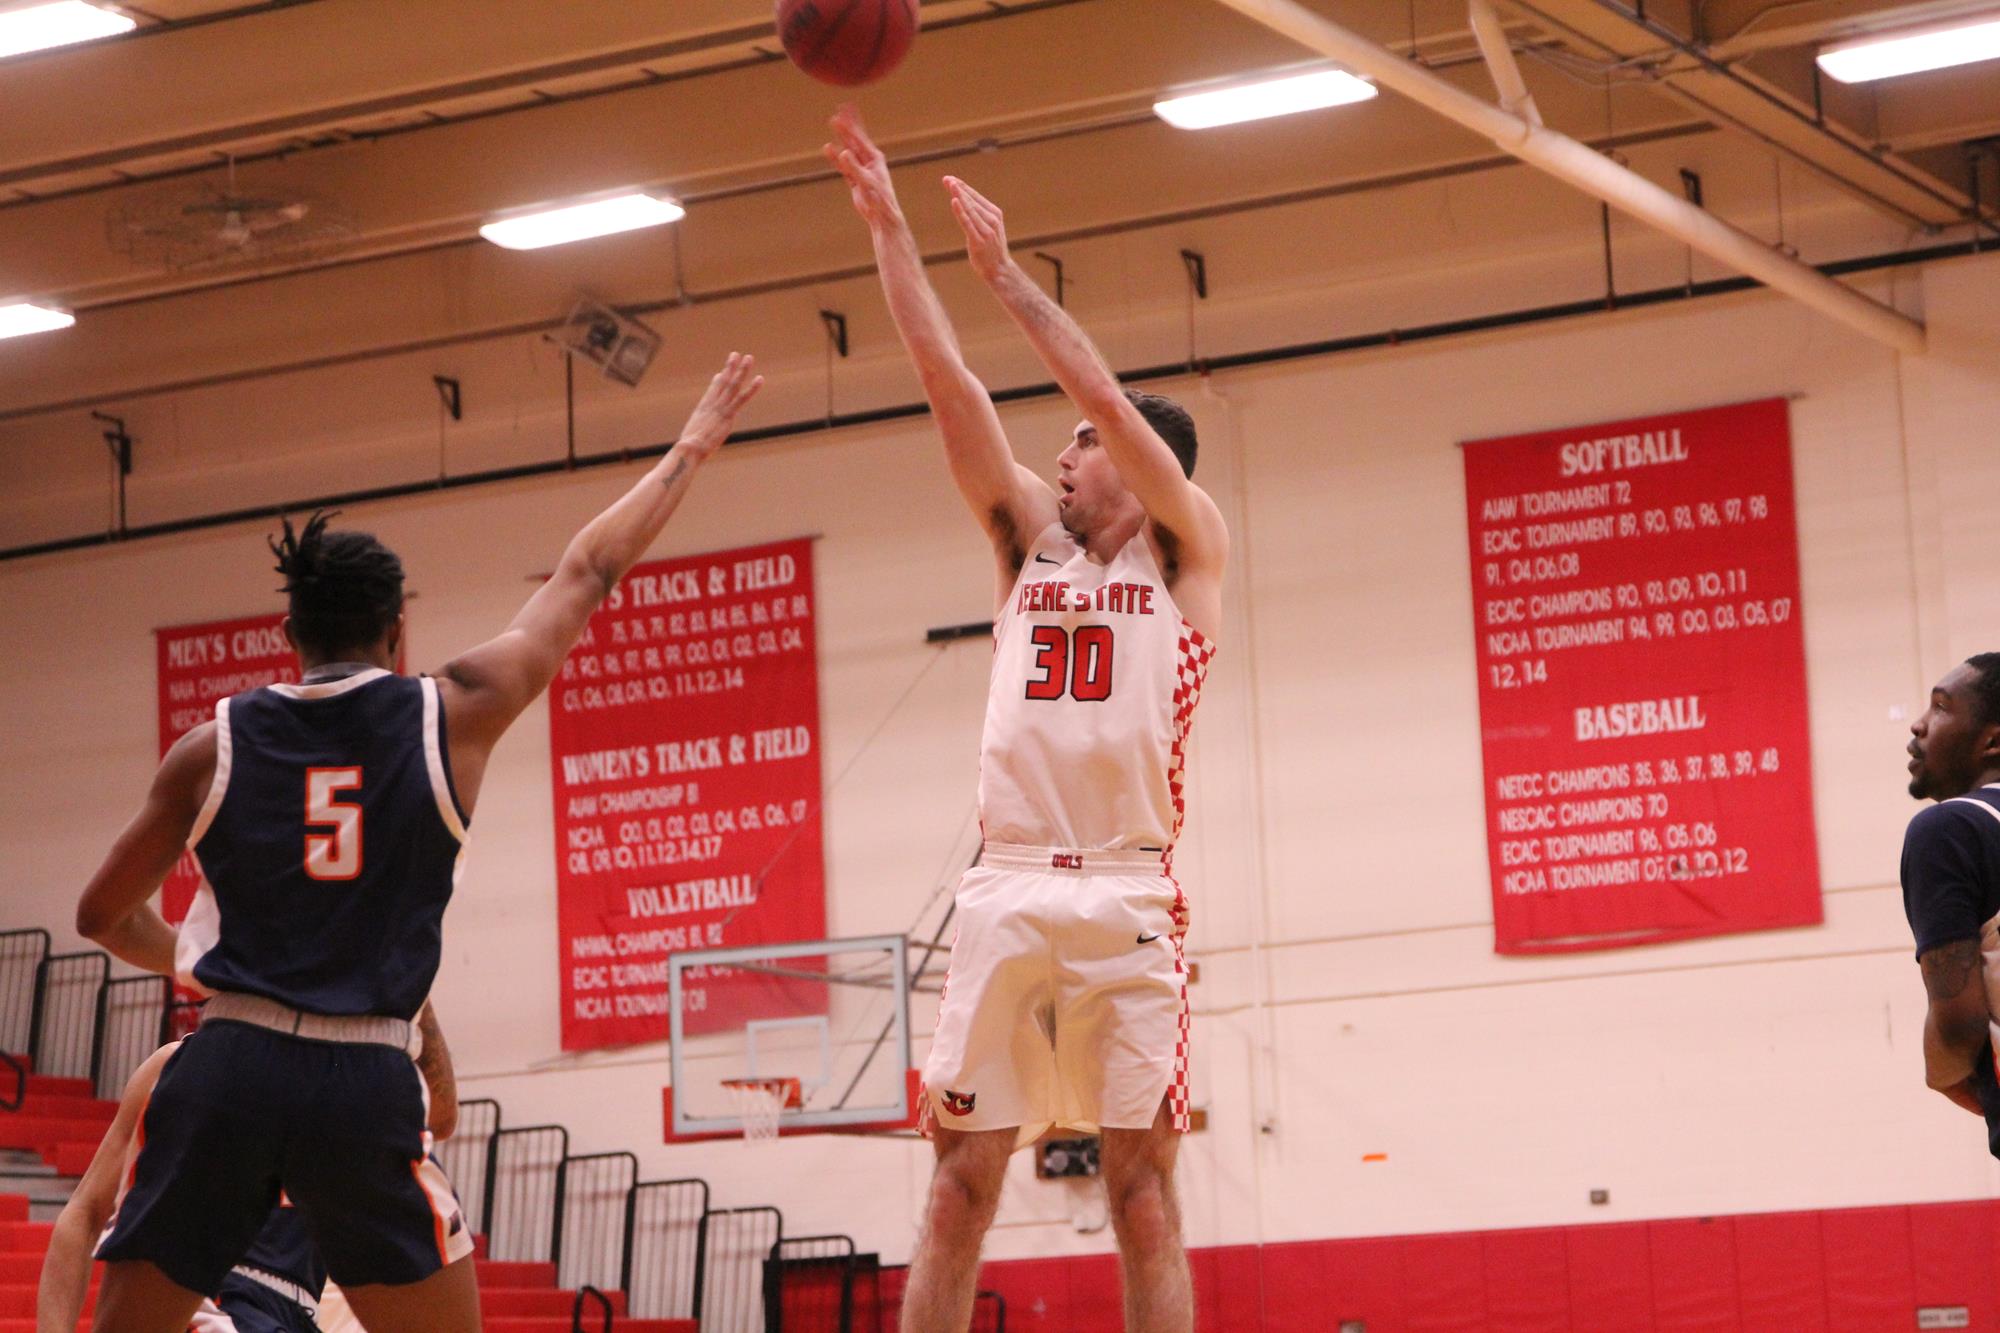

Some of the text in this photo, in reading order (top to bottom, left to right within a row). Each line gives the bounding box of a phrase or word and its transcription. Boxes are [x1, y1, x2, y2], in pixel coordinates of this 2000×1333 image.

[1560, 428, 1688, 476] SOFTBALL
[1523, 484, 1610, 516] TOURNAMENT
[1615, 481, 1631, 503] 72
[1483, 528, 1521, 554] ECAC
[1527, 516, 1614, 548] TOURNAMENT
[1750, 495, 1768, 519] 98
[630, 569, 700, 608] TRACK
[708, 566, 726, 597] &
[733, 554, 795, 593] FIELD
[1075, 582, 1154, 615] STATE
[1486, 597, 1525, 624] ECAC
[1531, 586, 1612, 620] CHAMPIONS
[168, 633, 226, 668] MEN'S
[1487, 628, 1531, 656] NCAA
[1535, 618, 1624, 651] TOURNAMENT
[1025, 625, 1114, 701] 30
[1575, 696, 1706, 741] BASEBALL
[562, 725, 811, 785] WOMEN'S TRACK & FIELD
[1499, 774, 1543, 800] NETCC
[1549, 764, 1630, 795] CHAMPIONS
[1761, 747, 1780, 773] 48
[304, 766, 363, 880] 5
[1499, 792, 1668, 832] NESCAC CHAMPIONS 70
[1052, 854, 1083, 869] OWLS
[1500, 837, 1541, 866] ECAC
[1545, 829, 1634, 861] TOURNAMENT
[627, 874, 757, 919] VOLLEYBALL
[1504, 868, 1547, 895] NCAA
[1551, 859, 1640, 890] TOURNAMENT
[573, 966, 608, 990] ECAC
[611, 960, 670, 987] TOURNAME
[574, 995, 612, 1019] NCAA
